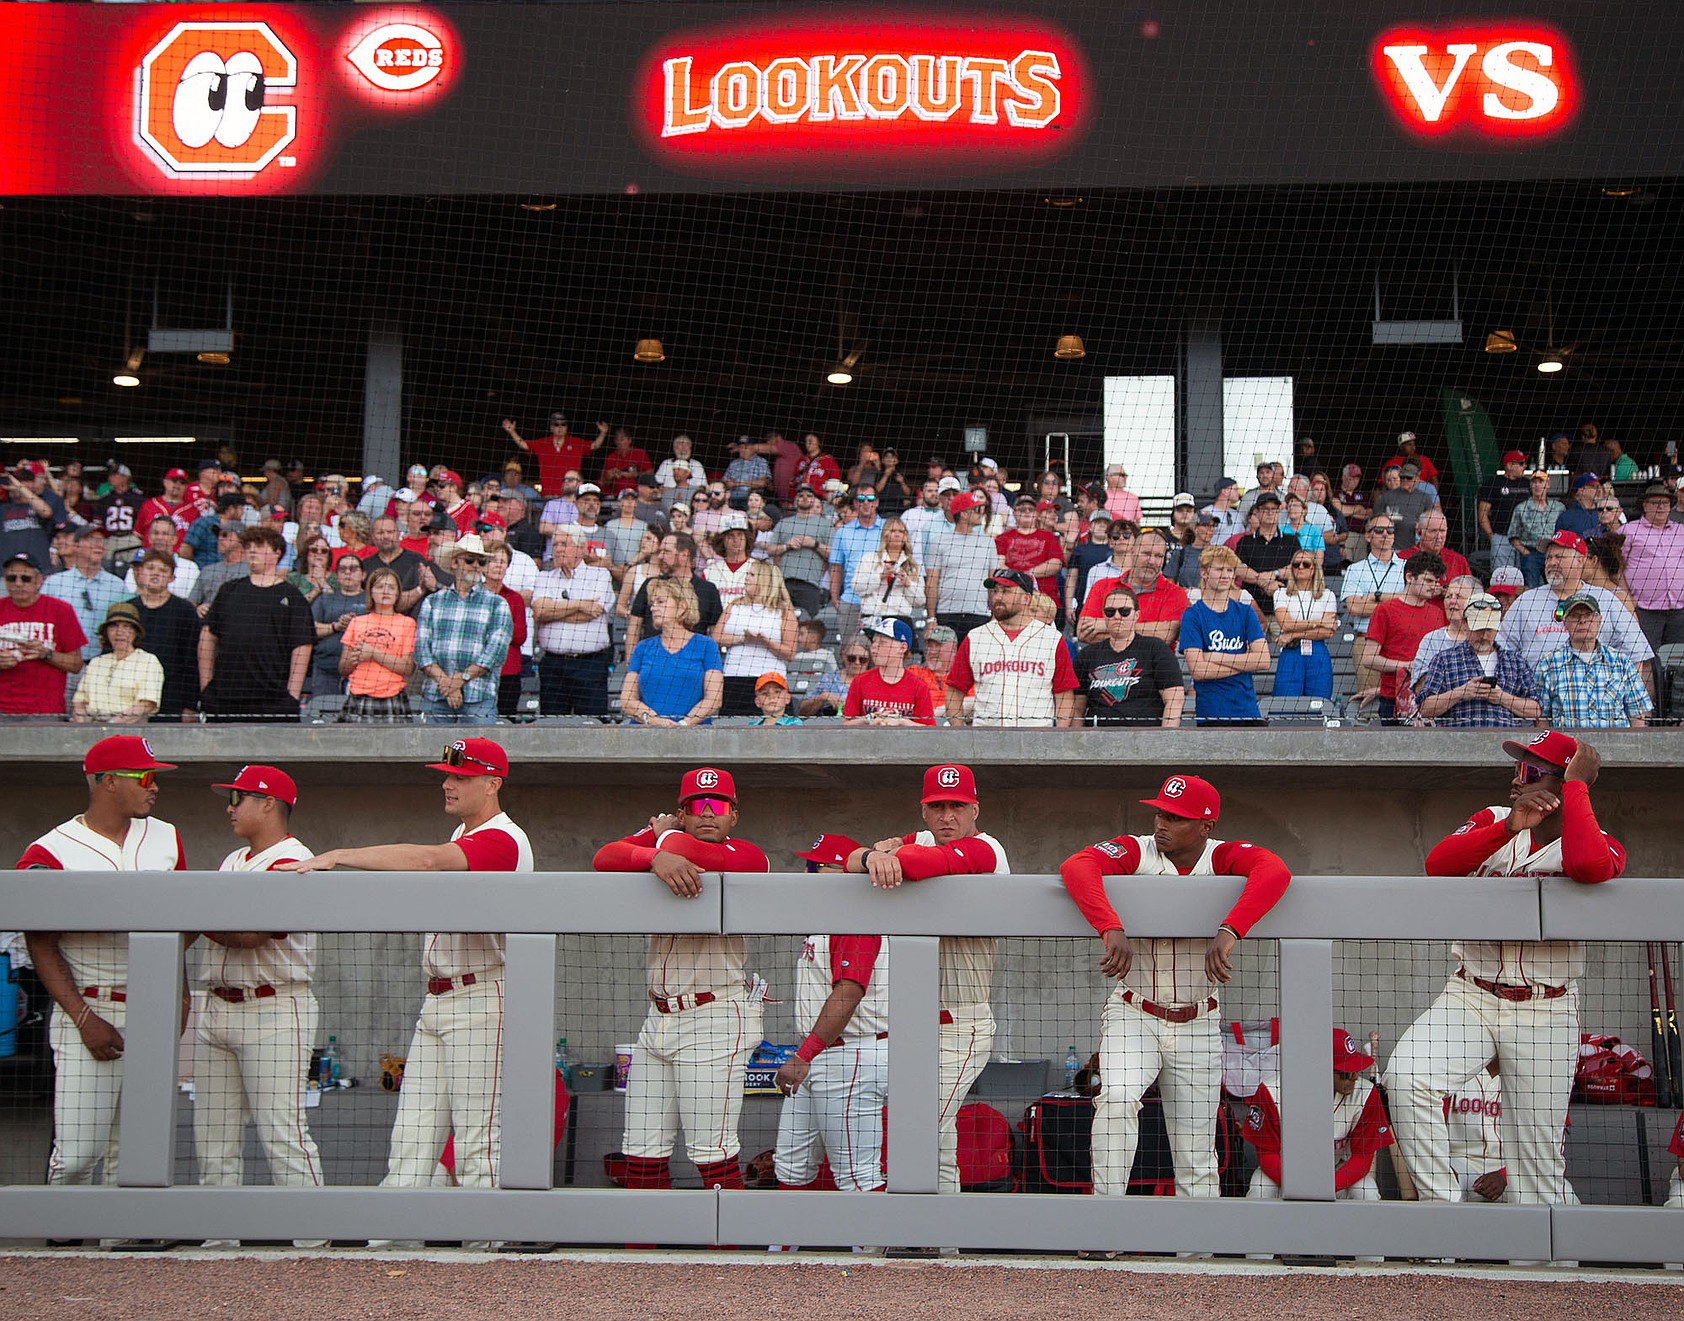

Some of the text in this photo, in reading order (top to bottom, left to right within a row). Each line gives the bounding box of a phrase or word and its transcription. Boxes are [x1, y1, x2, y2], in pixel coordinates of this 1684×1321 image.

[376, 48, 443, 67] REDS
[1383, 41, 1559, 122] VS
[661, 50, 1062, 137] LOOKOUTS
[106, 506, 133, 531] 25
[1208, 629, 1244, 651] Bucs
[979, 660, 1045, 677] LOOKOUTS
[1451, 1094, 1502, 1117] LOOKO
